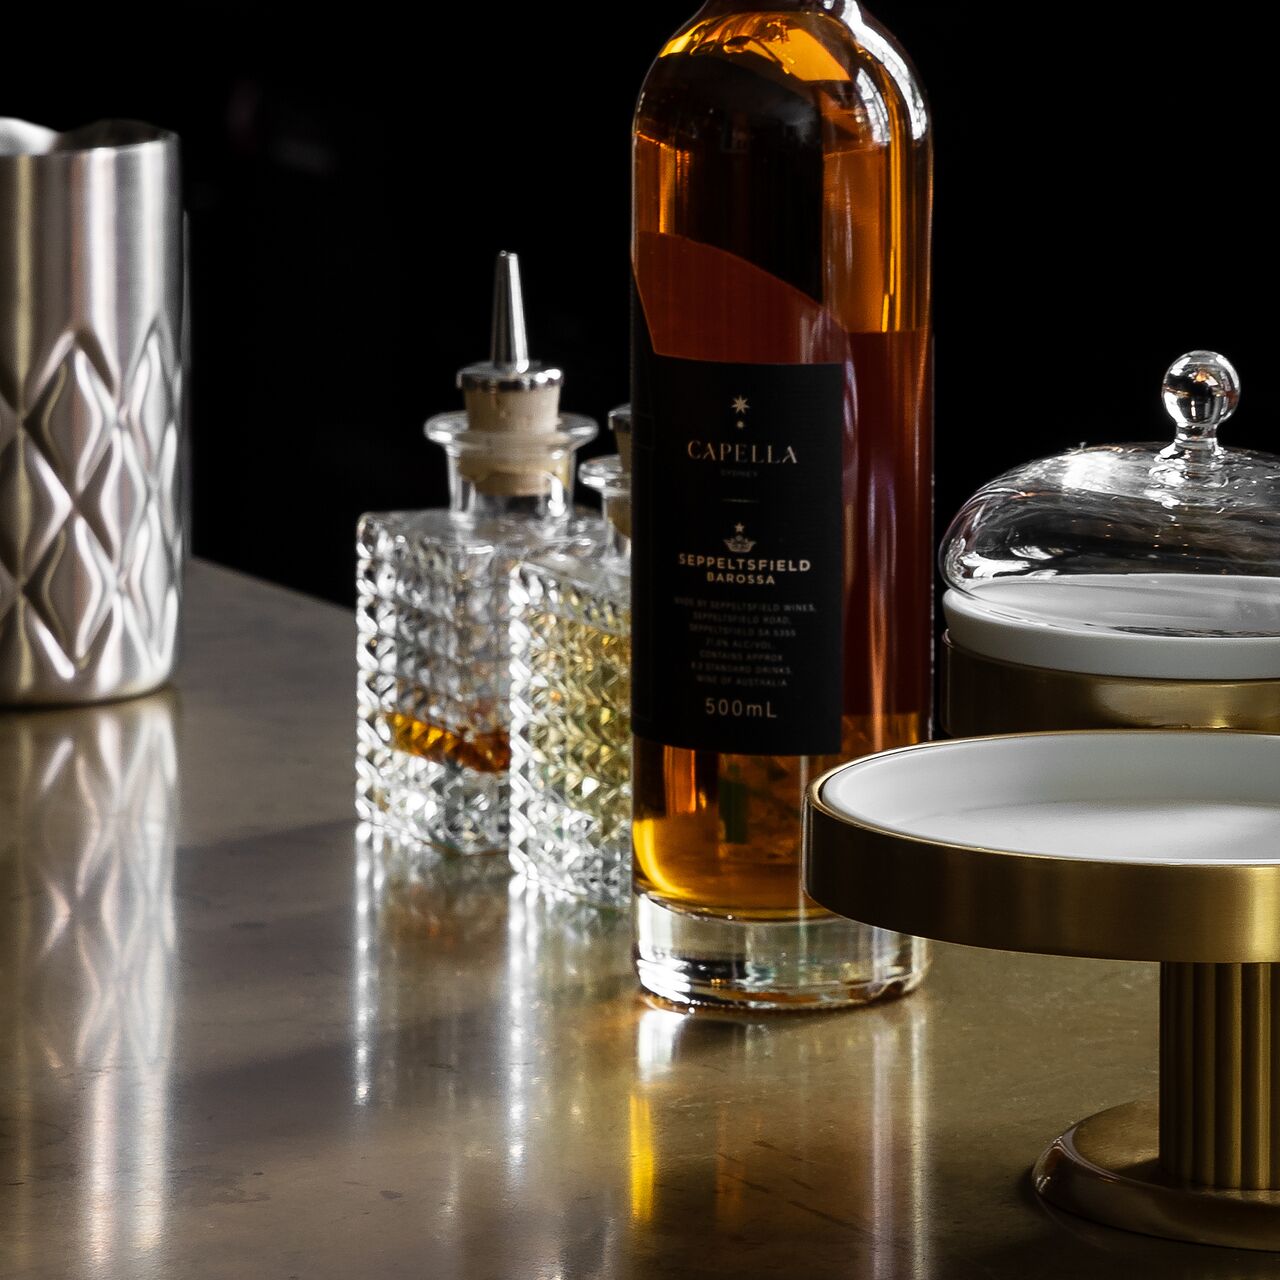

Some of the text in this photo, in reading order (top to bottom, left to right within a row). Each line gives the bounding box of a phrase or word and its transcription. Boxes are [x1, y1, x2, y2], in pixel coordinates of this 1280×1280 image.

[687, 440, 799, 464] CAPELLA
[678, 553, 811, 572] SEPPELTSFIELD
[707, 572, 775, 585] BAROSSA
[705, 698, 777, 718] 500mL
